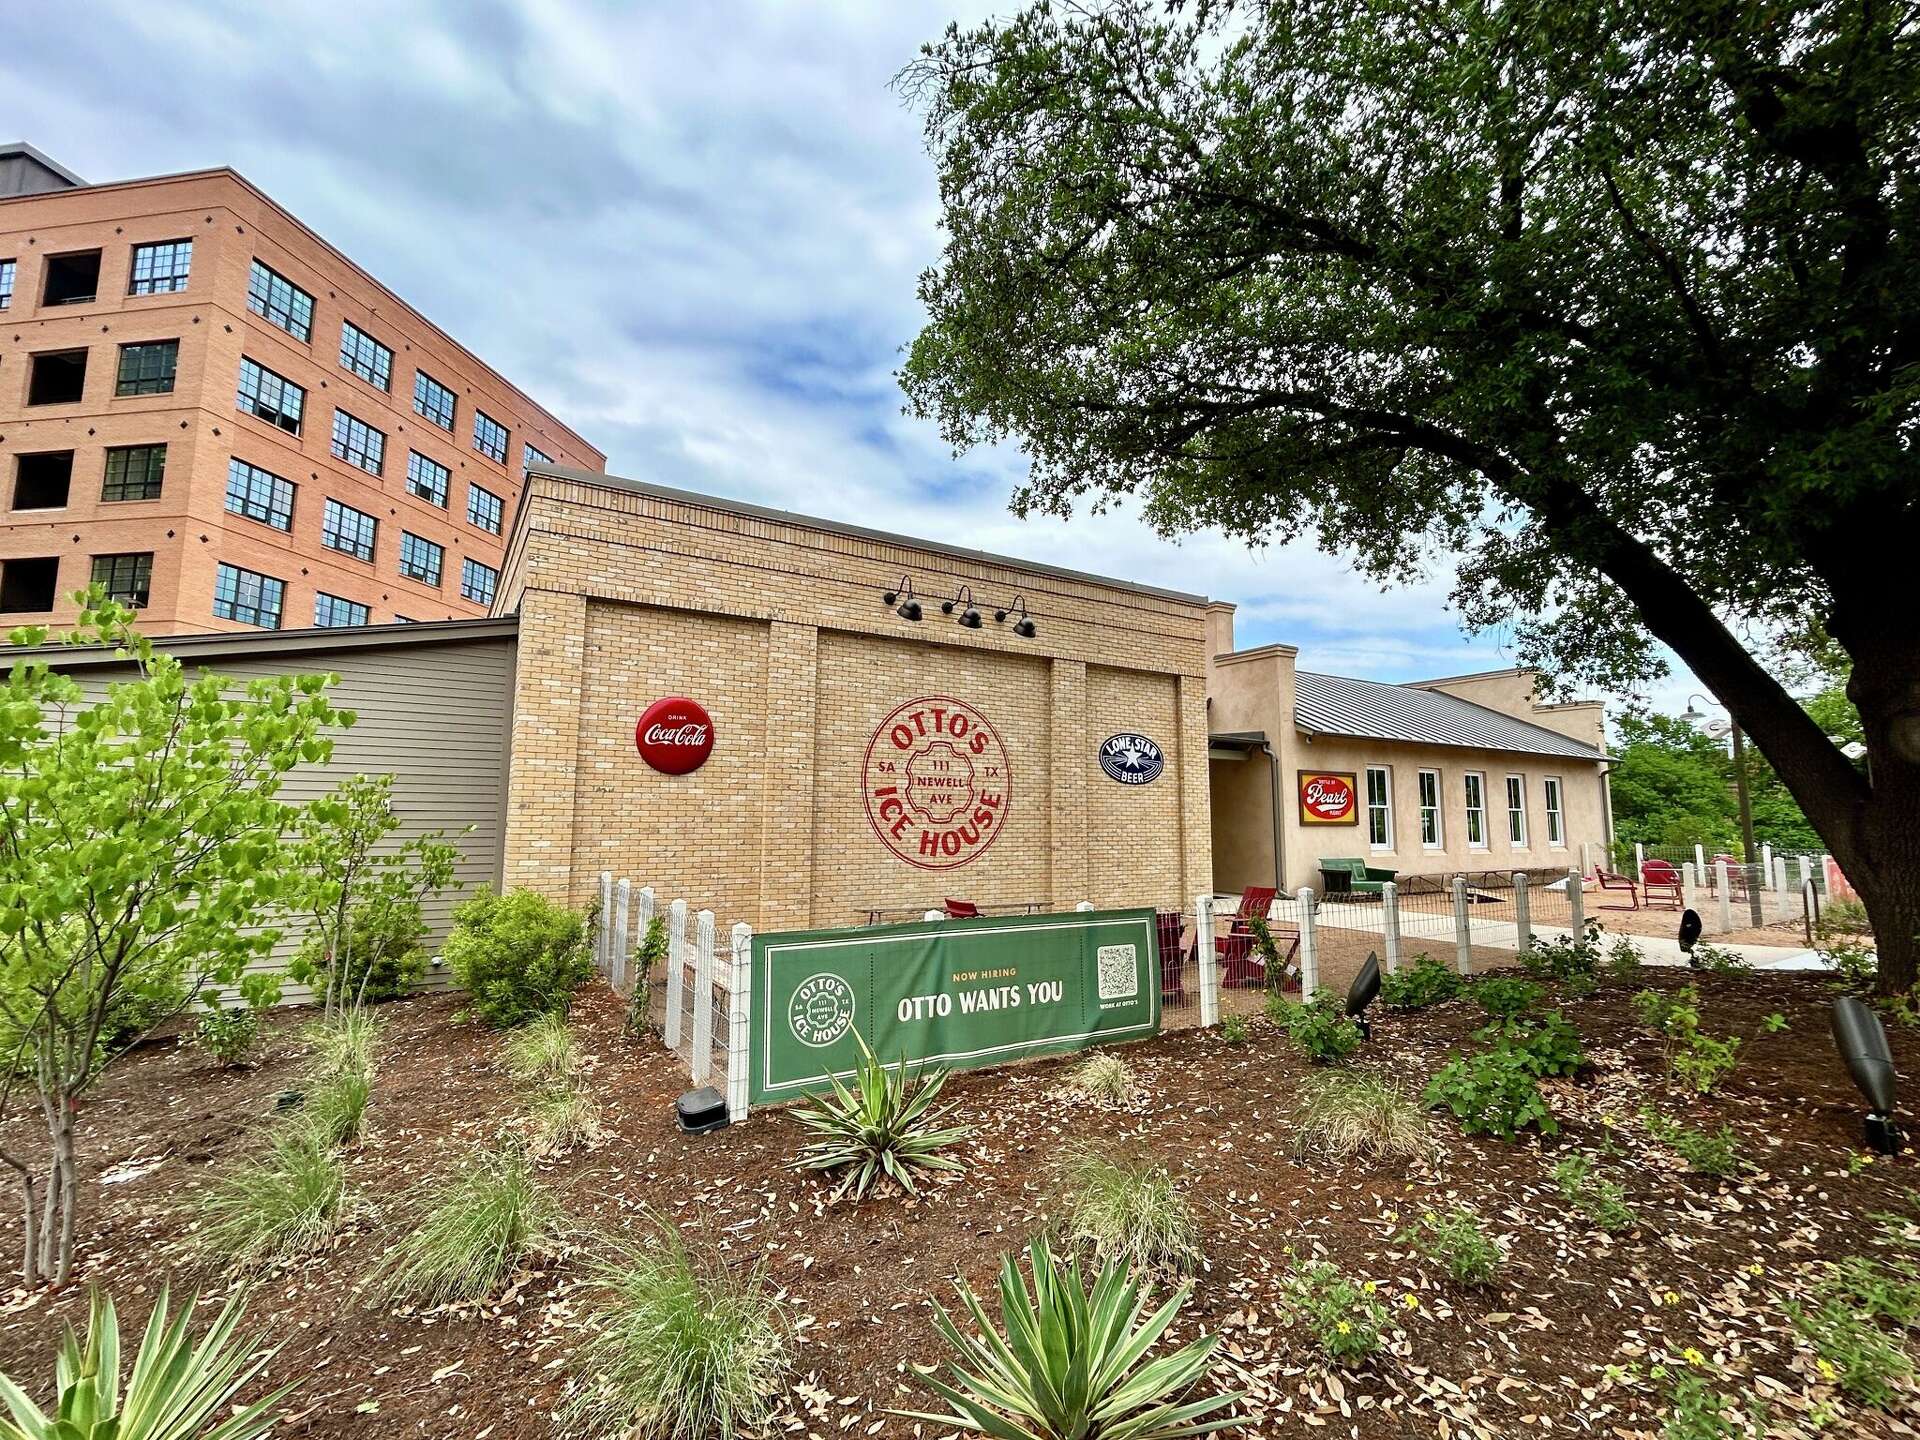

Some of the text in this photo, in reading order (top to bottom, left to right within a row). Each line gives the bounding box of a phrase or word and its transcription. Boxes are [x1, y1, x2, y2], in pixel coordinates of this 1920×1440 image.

[644, 723, 708, 746] Coca-Cola
[890, 708, 989, 754] OTTO'S
[1105, 737, 1158, 760] LONE STAR
[878, 761, 999, 777] SA TX
[933, 760, 950, 771] 111
[917, 776, 964, 788] NEWELL
[1121, 771, 1144, 783] BEER
[930, 794, 952, 804] AVE
[1307, 783, 1347, 806] Pearl
[874, 786, 1001, 857] ICE HOUSE
[952, 967, 1016, 982] NOW HIRING
[800, 978, 845, 1000] OTTO'S
[897, 980, 1063, 1022] OTTO WANTS YOU
[793, 1009, 850, 1042] ICE HOUSE
